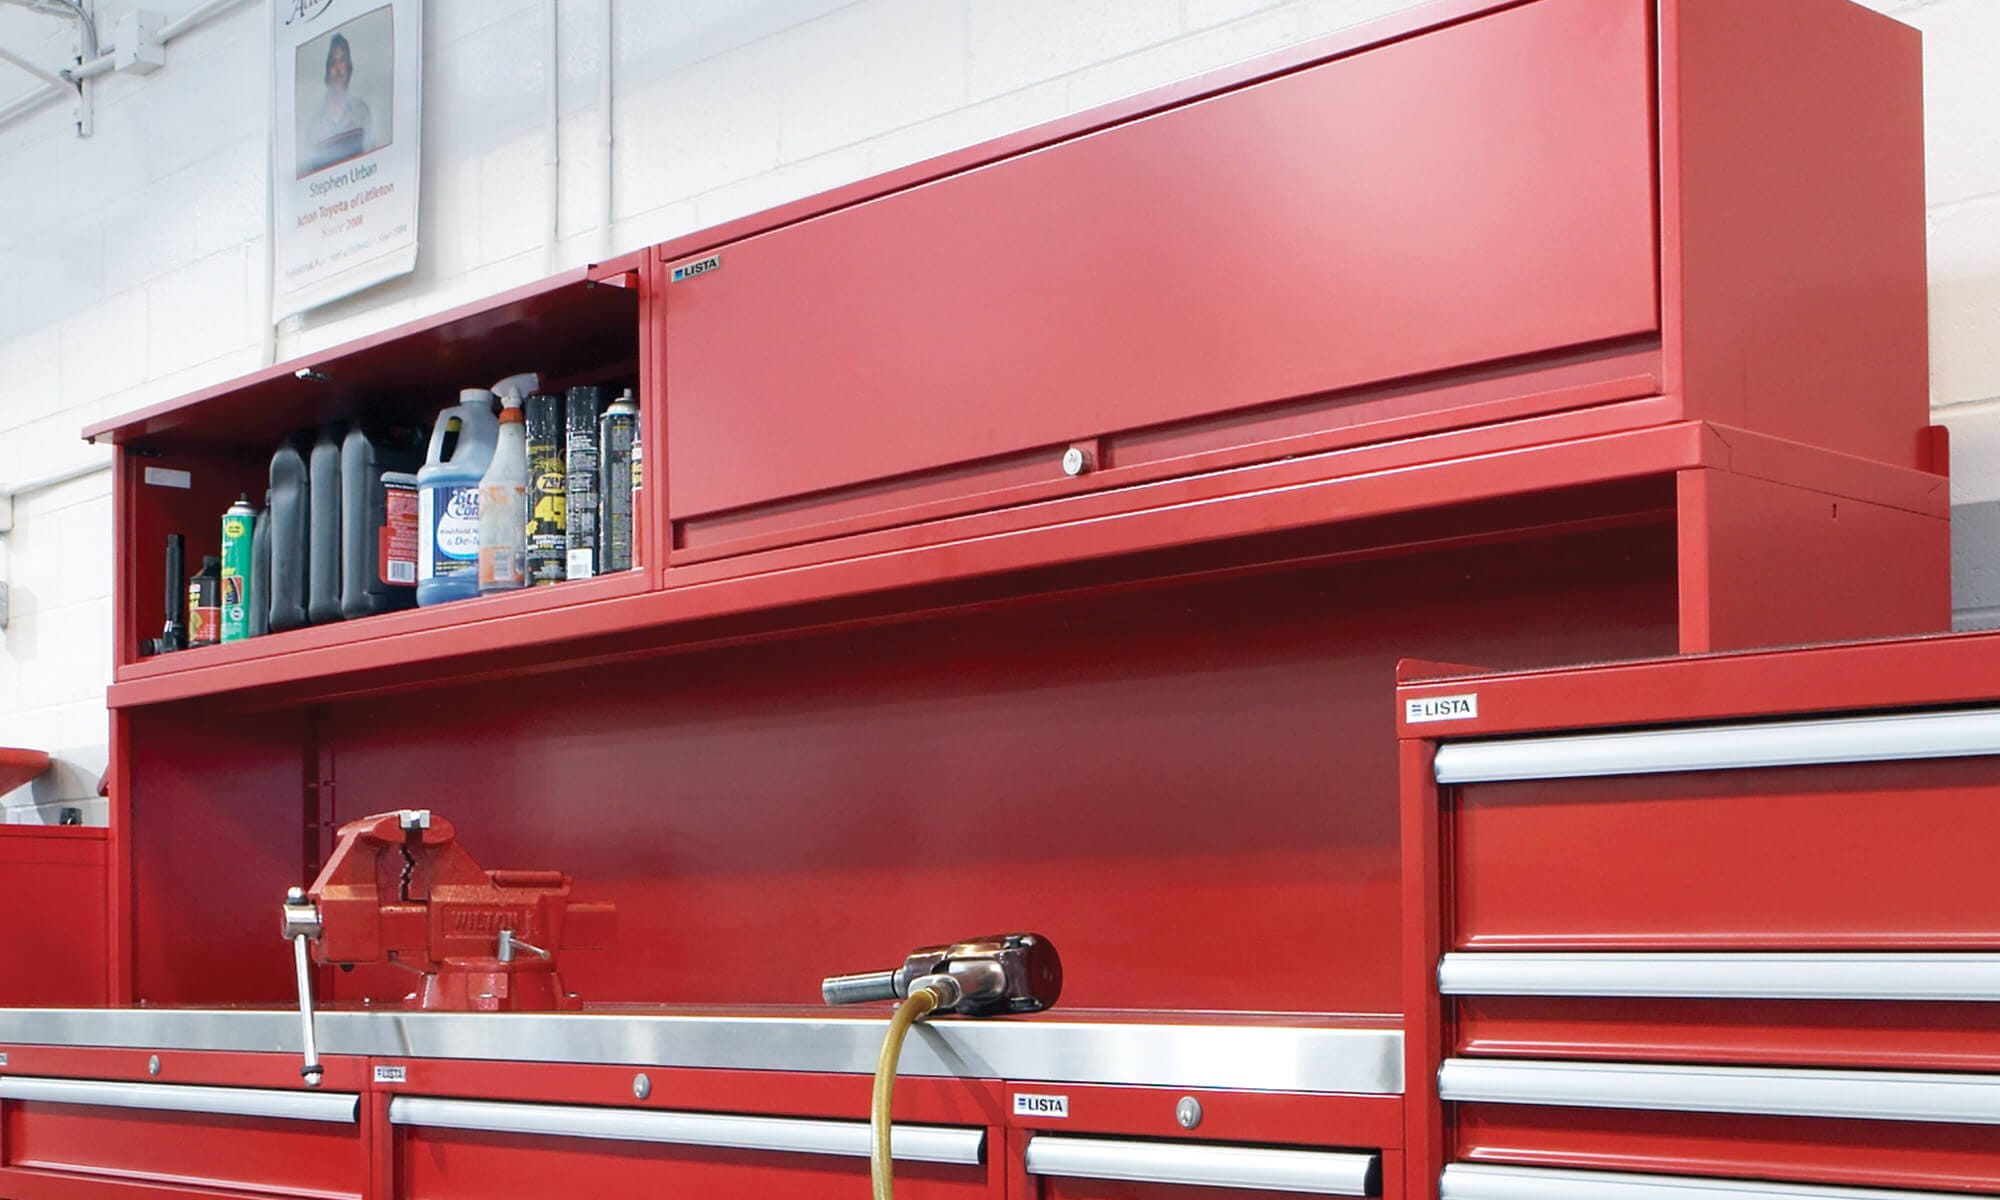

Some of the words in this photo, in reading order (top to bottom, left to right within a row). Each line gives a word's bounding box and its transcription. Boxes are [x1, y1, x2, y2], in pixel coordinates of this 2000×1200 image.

[310, 173, 348, 198] Stephen
[350, 163, 378, 183] Urban
[319, 200, 349, 219] Toyota
[361, 183, 395, 205] Littleton
[684, 258, 717, 277] LISTA
[1425, 699, 1470, 716] LISTA
[451, 911, 518, 931] WILTON
[1028, 1098, 1063, 1112] LISTA
